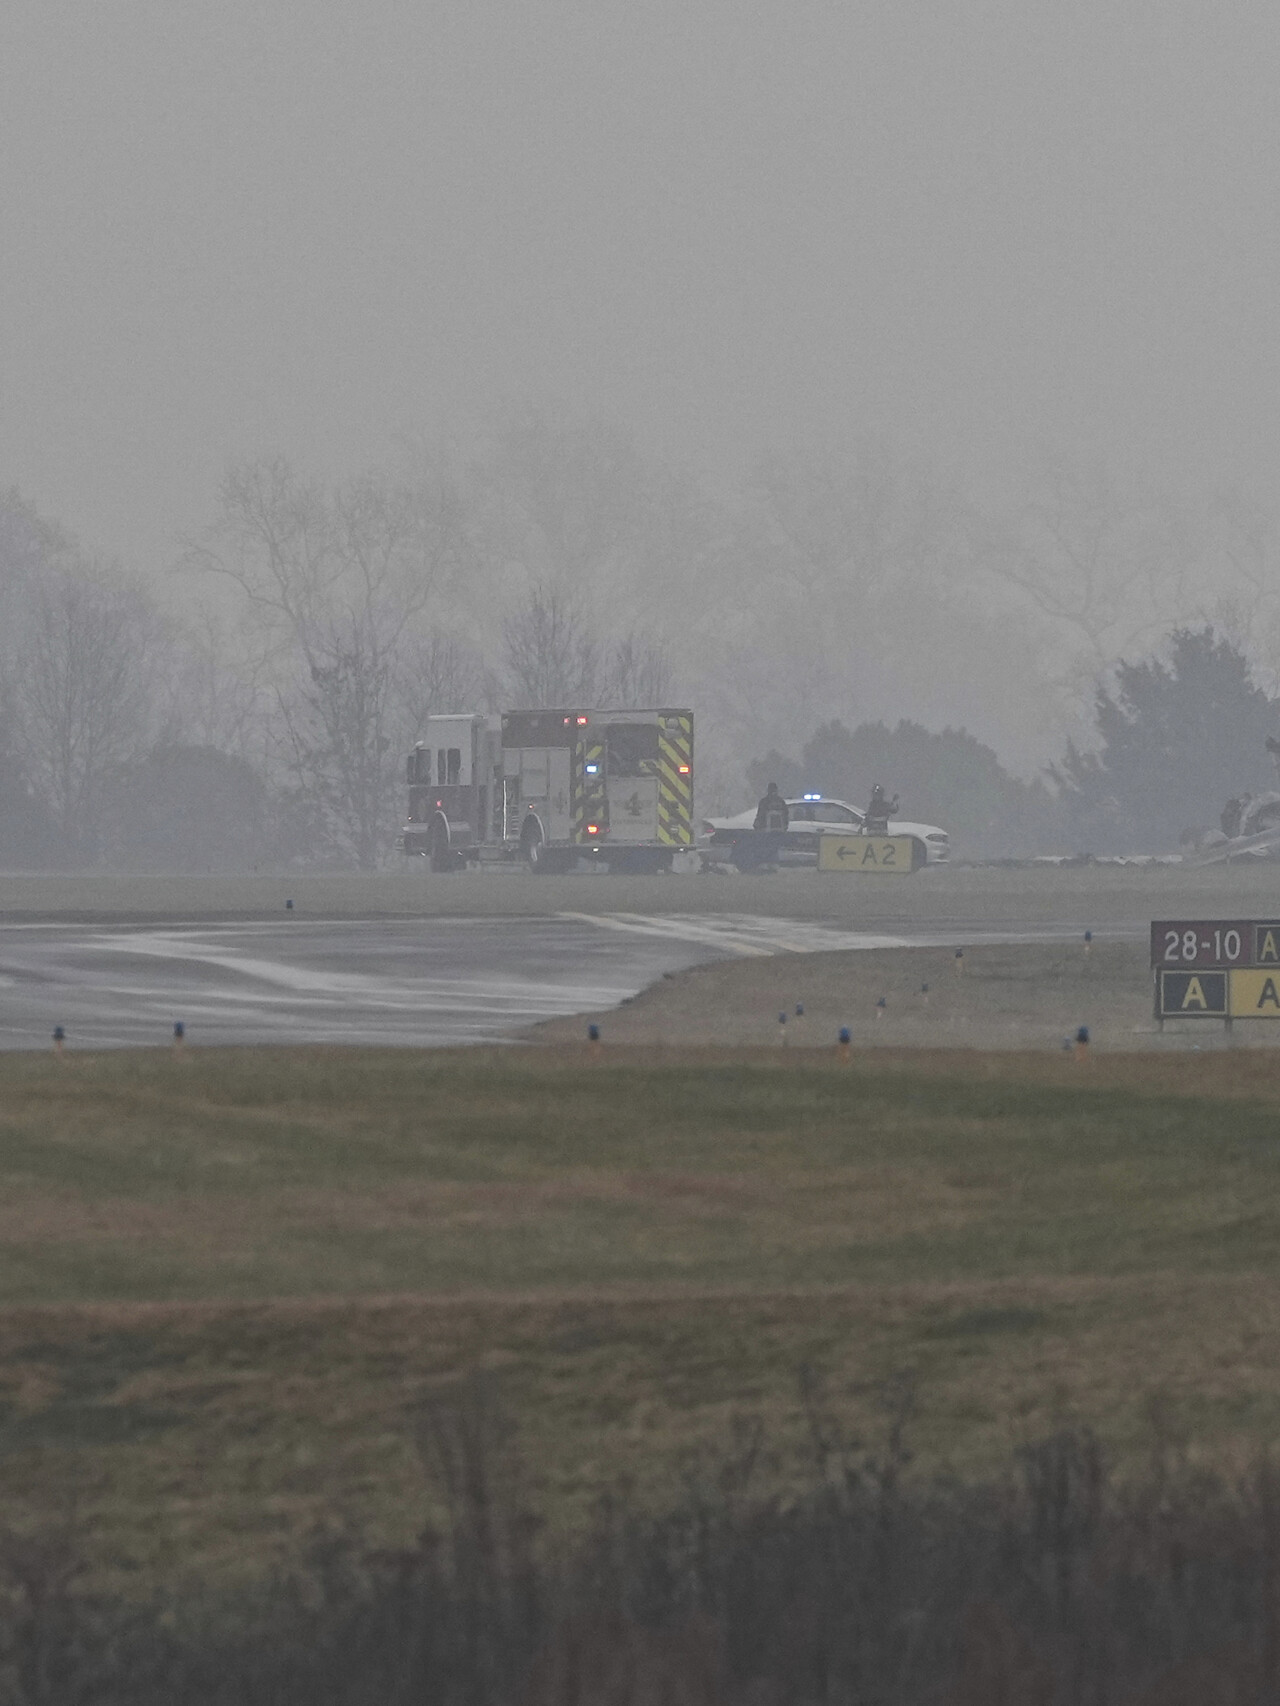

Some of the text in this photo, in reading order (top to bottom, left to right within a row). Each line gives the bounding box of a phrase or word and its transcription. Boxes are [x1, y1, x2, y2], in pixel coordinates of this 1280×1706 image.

[624, 792, 643, 816] 4
[861, 843, 896, 865] A2
[1164, 930, 1241, 961] 28-10
[1181, 976, 1207, 1009] A
